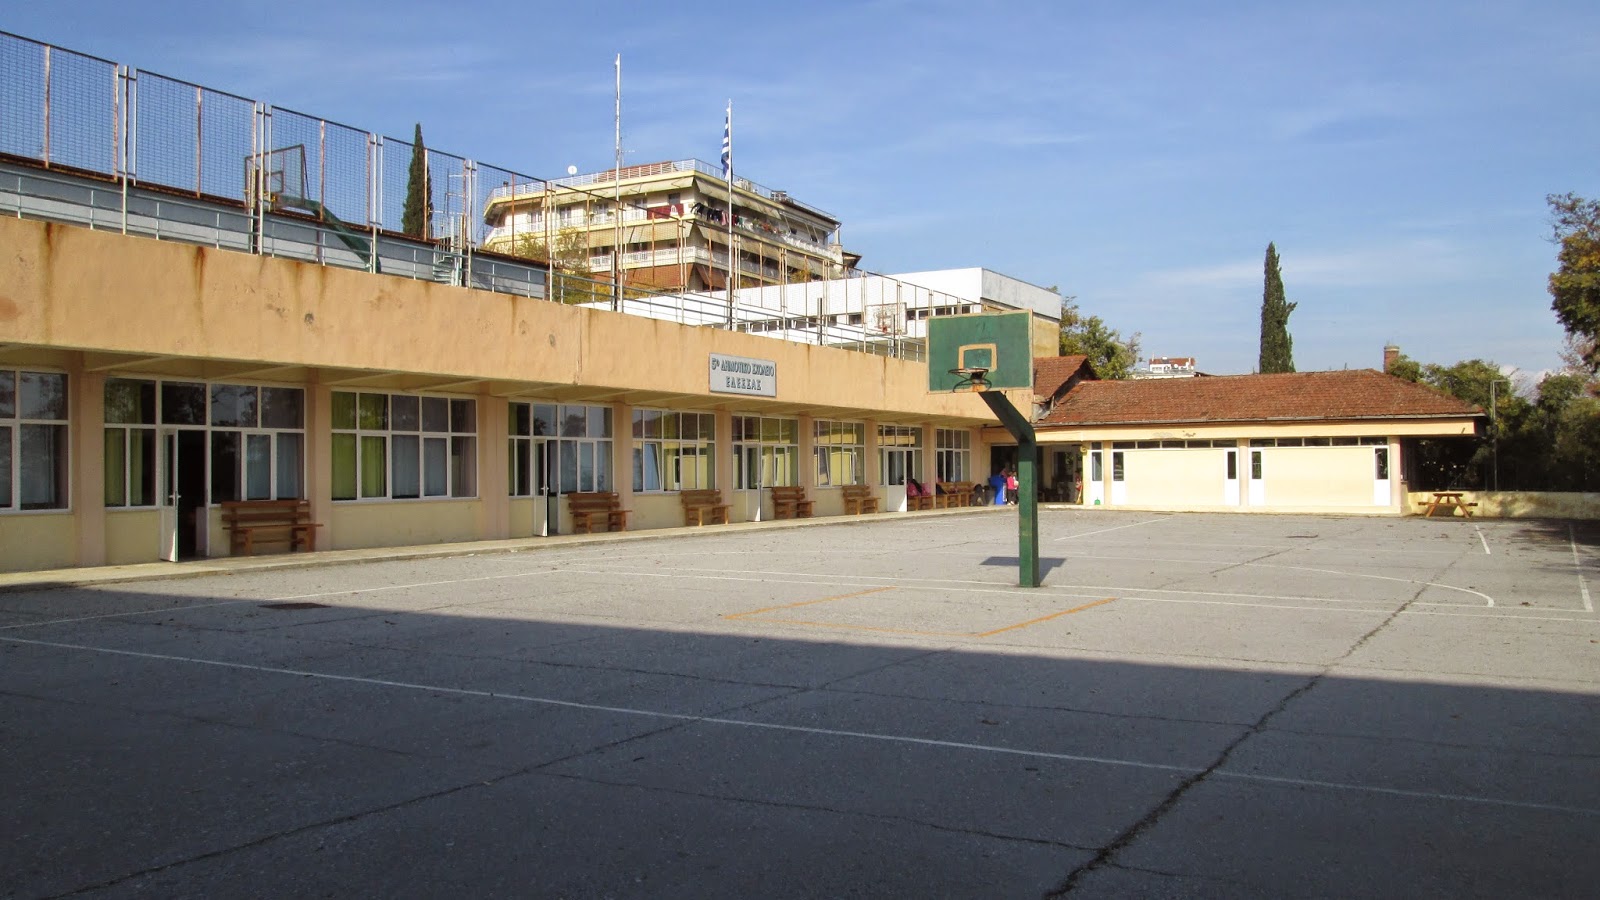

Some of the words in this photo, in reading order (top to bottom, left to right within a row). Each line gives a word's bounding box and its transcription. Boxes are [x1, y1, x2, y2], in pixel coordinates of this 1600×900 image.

[721, 360, 752, 374] ΔΗΜΟΤΙΚΟ
[752, 363, 774, 377] ΣΧΟΛΕΙΟ
[726, 376, 761, 390] ΕΔΕΣΣΑΣ
